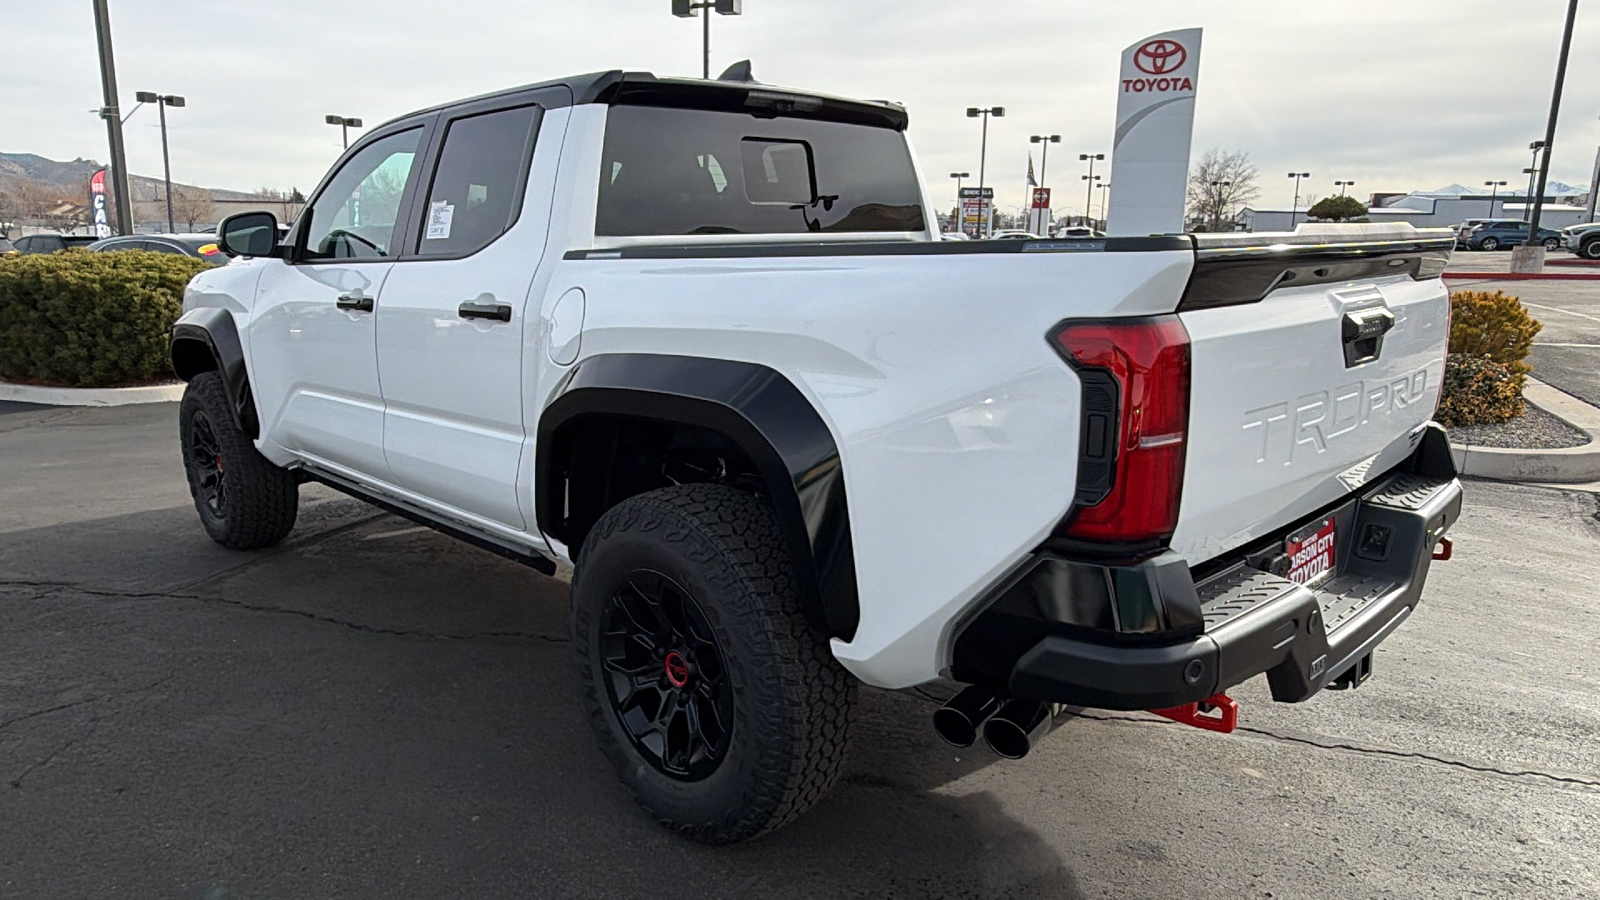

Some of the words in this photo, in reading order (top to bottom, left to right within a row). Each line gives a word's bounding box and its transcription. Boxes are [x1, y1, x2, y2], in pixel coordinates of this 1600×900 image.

[1122, 77, 1193, 93] TOYOTA
[1242, 380, 1364, 466] TRD
[1361, 369, 1427, 425] PRO
[1290, 543, 1317, 569] ARSON
[1317, 531, 1335, 553] CITY
[1290, 551, 1329, 584] TOYOTA
